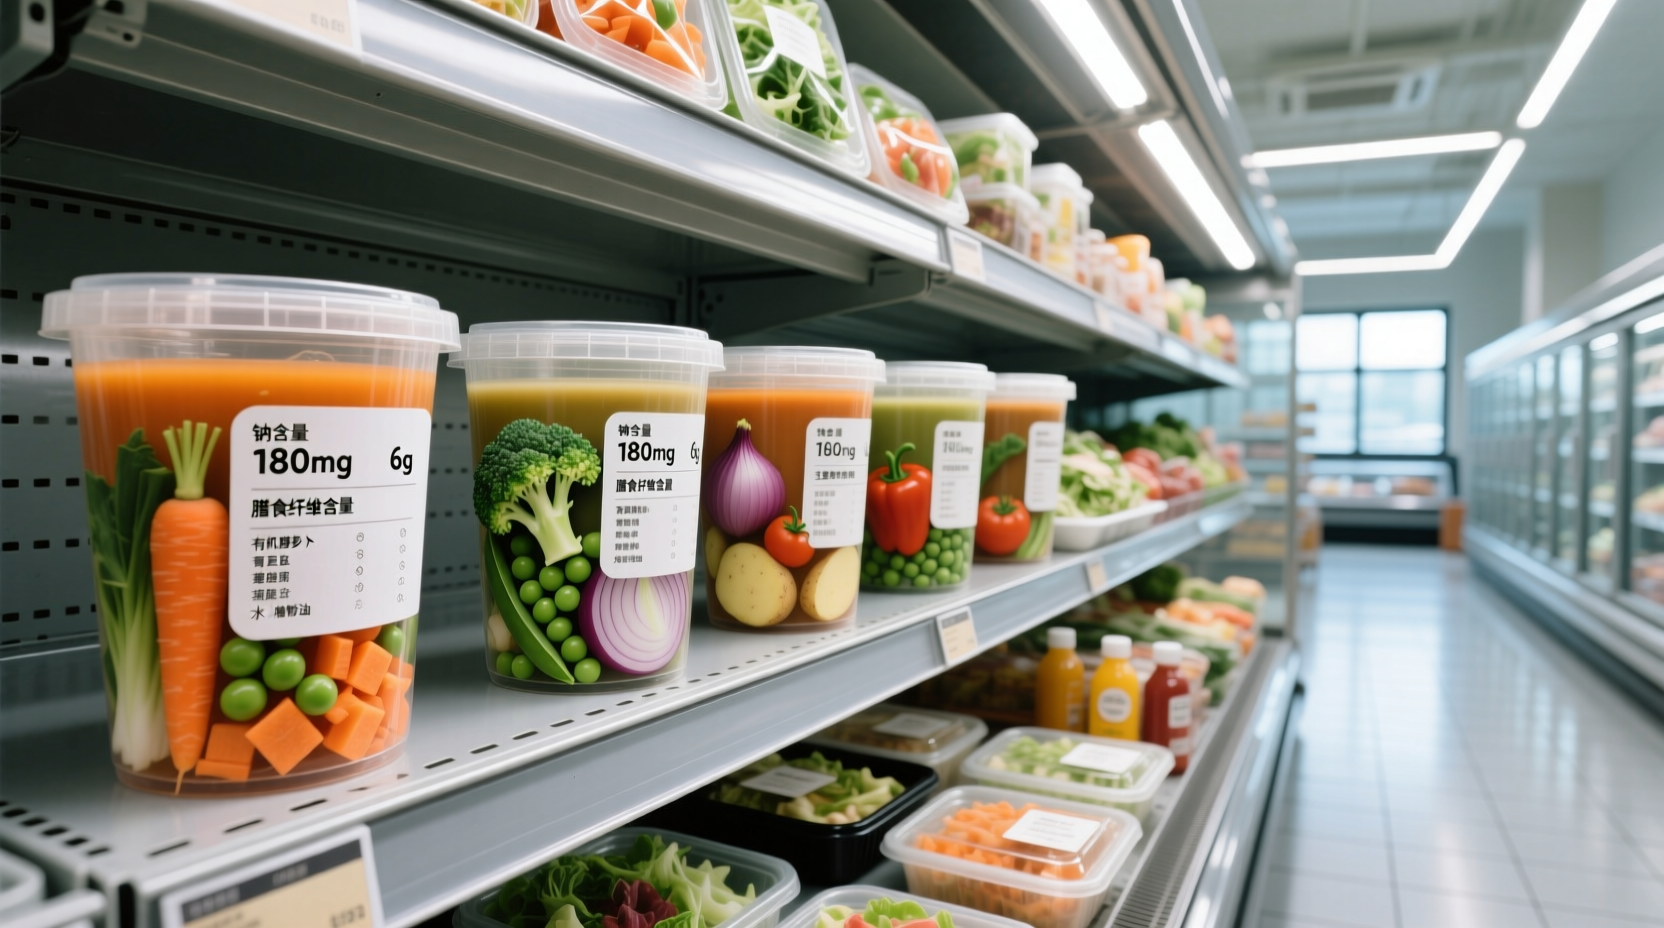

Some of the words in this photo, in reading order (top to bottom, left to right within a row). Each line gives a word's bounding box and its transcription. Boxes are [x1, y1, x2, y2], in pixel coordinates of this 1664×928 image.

[252, 423, 309, 442] 钠含量
[253, 447, 352, 479] 180mg
[390, 446, 413, 475] 6g
[618, 441, 675, 466] 180mg
